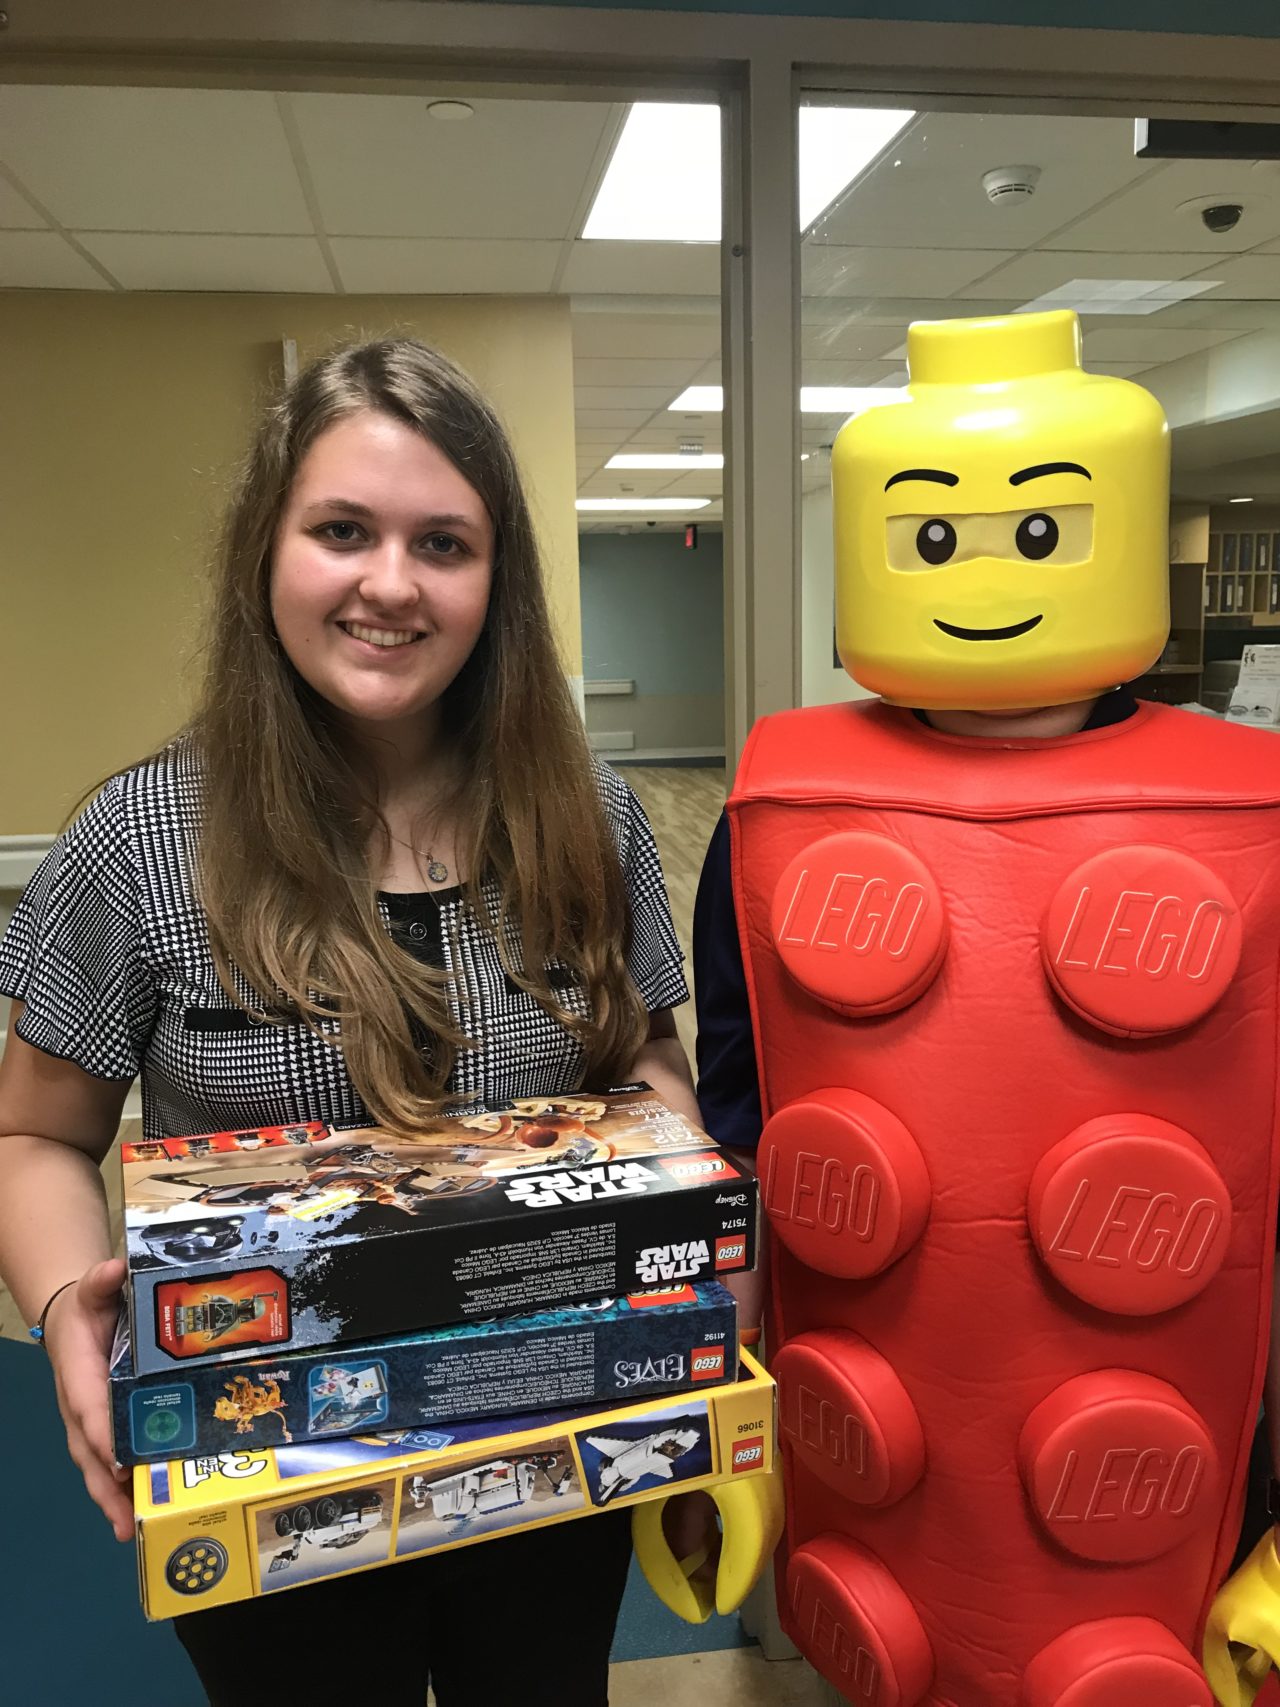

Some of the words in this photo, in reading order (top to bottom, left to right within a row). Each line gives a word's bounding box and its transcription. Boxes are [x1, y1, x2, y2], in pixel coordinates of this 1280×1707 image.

[778, 869, 927, 961] LEGO
[1056, 886, 1230, 985] LEGO
[644, 1112, 674, 1120] 277
[650, 1132, 700, 1144] 7-12
[504, 1162, 660, 1196] WARS
[671, 1160, 726, 1178] LEGO
[508, 1175, 661, 1208] STAR
[765, 1144, 880, 1242] LEGO
[722, 1218, 747, 1230] 75174
[1050, 1179, 1222, 1279] LEGO
[636, 1240, 710, 1268] WARS
[717, 1244, 744, 1261] LEGO
[636, 1256, 710, 1283] STAR
[704, 1332, 726, 1341] 41192
[258, 1370, 290, 1381] Rowan
[693, 1356, 723, 1371] LEGO
[737, 1420, 764, 1433] 31066
[778, 1371, 870, 1479] LEGO
[198, 1458, 218, 1468] EN
[218, 1447, 268, 1478] 3
[734, 1446, 762, 1464] LEGO
[183, 1458, 210, 1488] 1
[204, 1464, 219, 1474] IN
[1047, 1445, 1206, 1522] LEGO
[792, 1575, 879, 1699] LEGO
